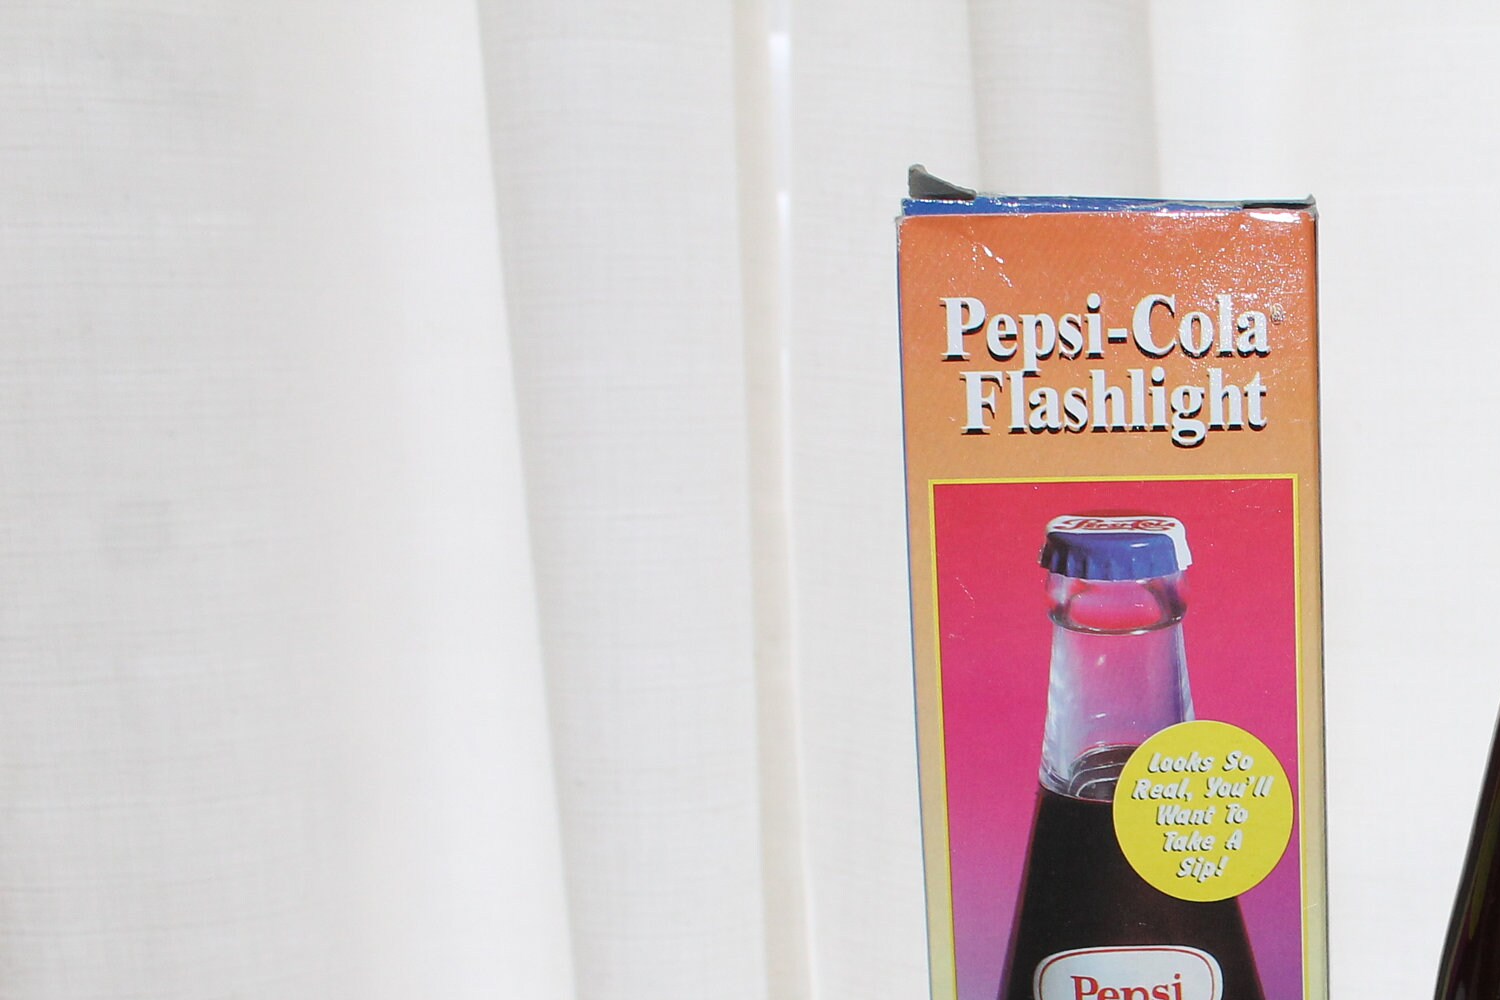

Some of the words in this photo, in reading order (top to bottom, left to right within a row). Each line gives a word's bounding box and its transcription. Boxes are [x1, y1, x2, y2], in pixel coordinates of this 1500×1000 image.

[959, 366, 1268, 449] Flashlight
[1148, 751, 1214, 773] Looks
[1222, 750, 1254, 772] So
[1131, 777, 1193, 801] Real,
[1204, 775, 1275, 798] You'll
[1156, 804, 1217, 825] Want
[1225, 803, 1249, 824] To
[1163, 830, 1216, 852] Take
[1225, 829, 1243, 850] A
[1176, 856, 1230, 883] Sip!
